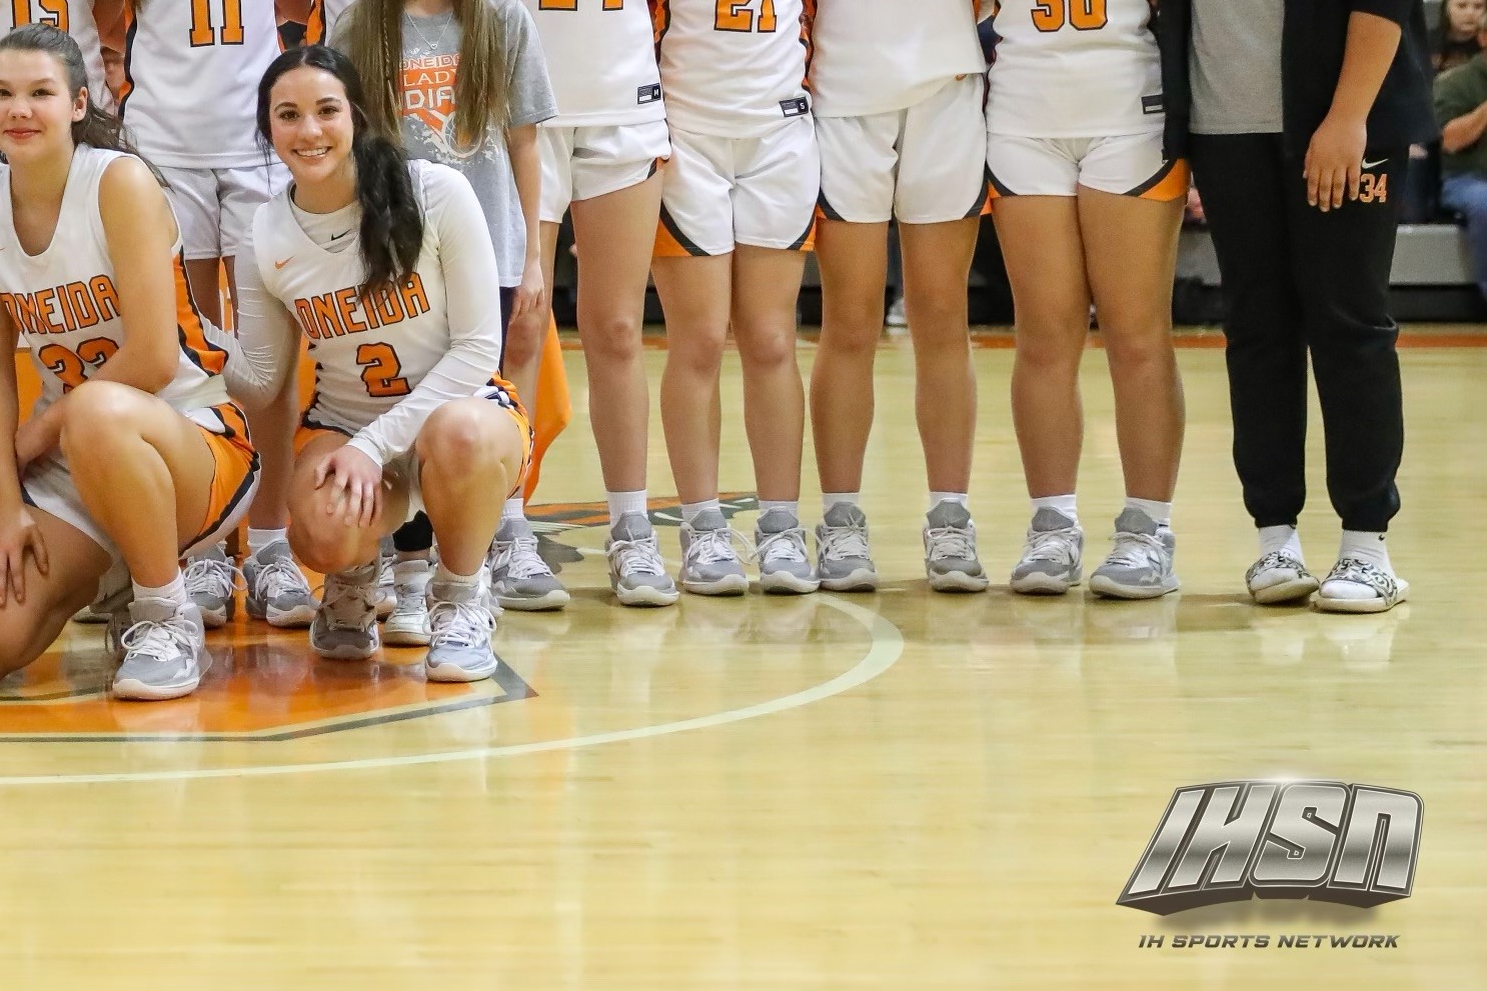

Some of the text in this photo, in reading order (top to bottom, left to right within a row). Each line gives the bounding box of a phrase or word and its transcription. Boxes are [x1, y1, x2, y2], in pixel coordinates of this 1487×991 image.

[1359, 173, 1388, 203] 34
[294, 271, 431, 341] ONEIDA
[356, 341, 412, 398] 2
